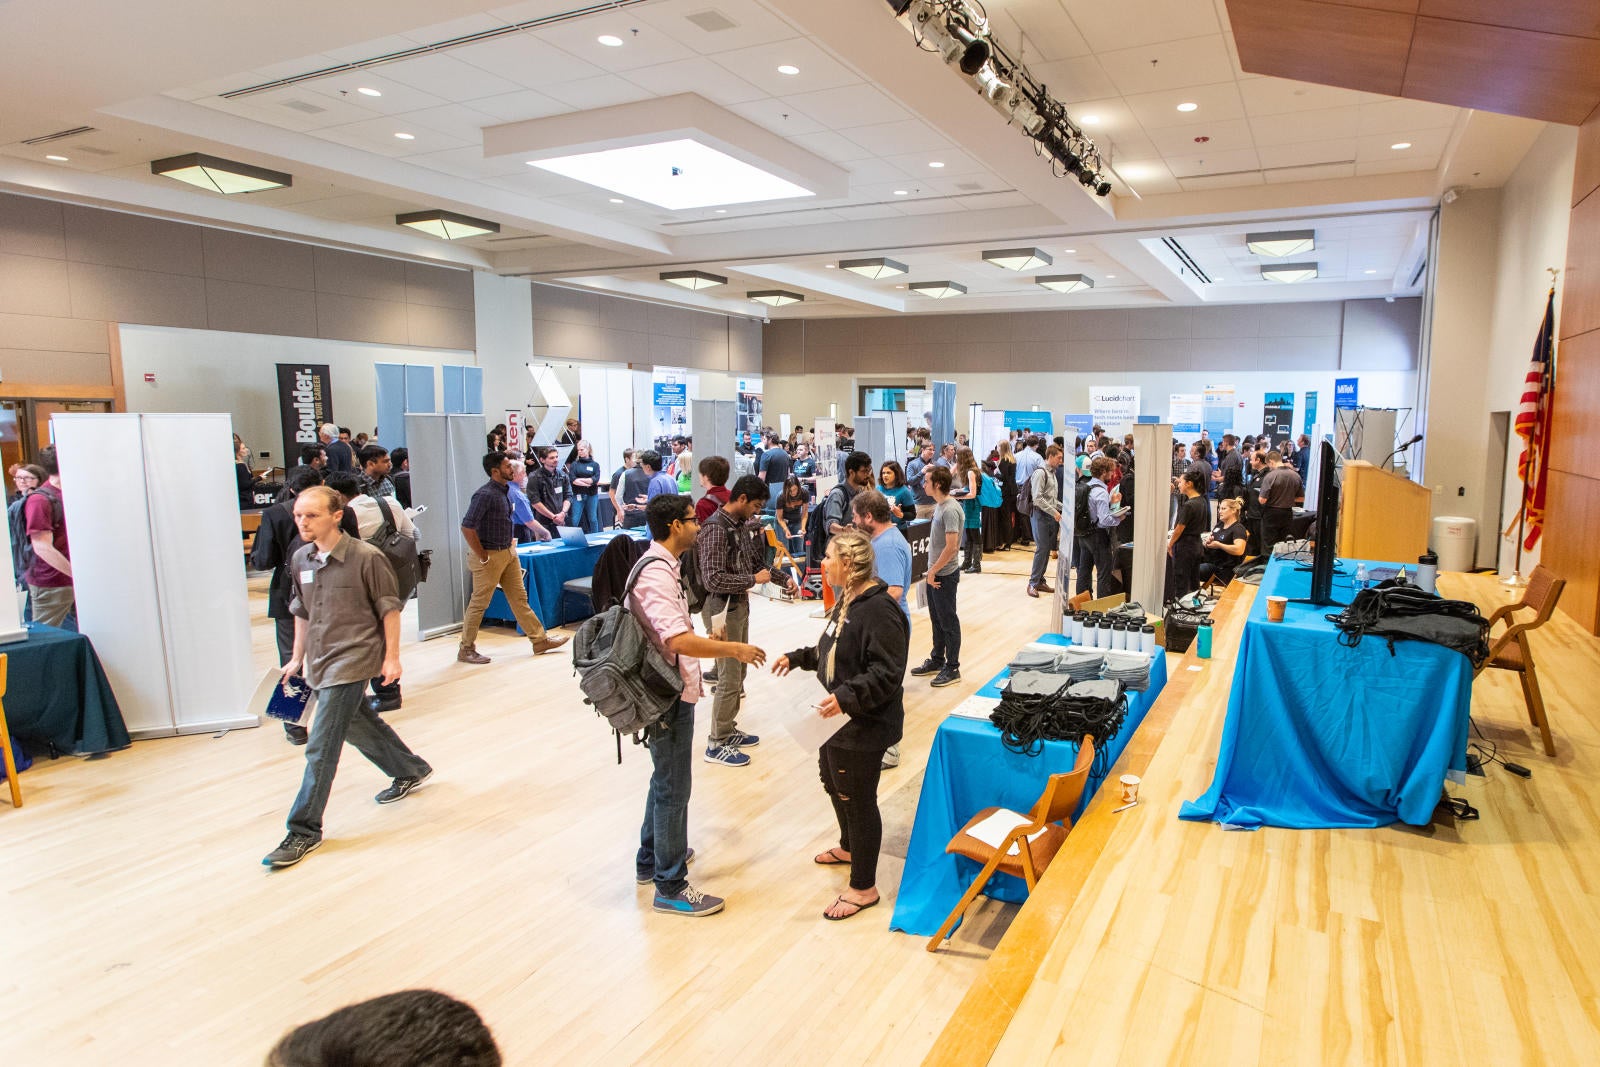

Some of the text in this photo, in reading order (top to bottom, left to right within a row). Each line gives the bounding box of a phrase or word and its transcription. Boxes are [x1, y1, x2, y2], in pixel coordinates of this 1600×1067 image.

[313, 375, 321, 401] CAREER
[292, 368, 317, 443] Boulder.
[315, 402, 323, 419] YOUR
[509, 414, 518, 450] ten
[911, 536, 931, 557] E42
